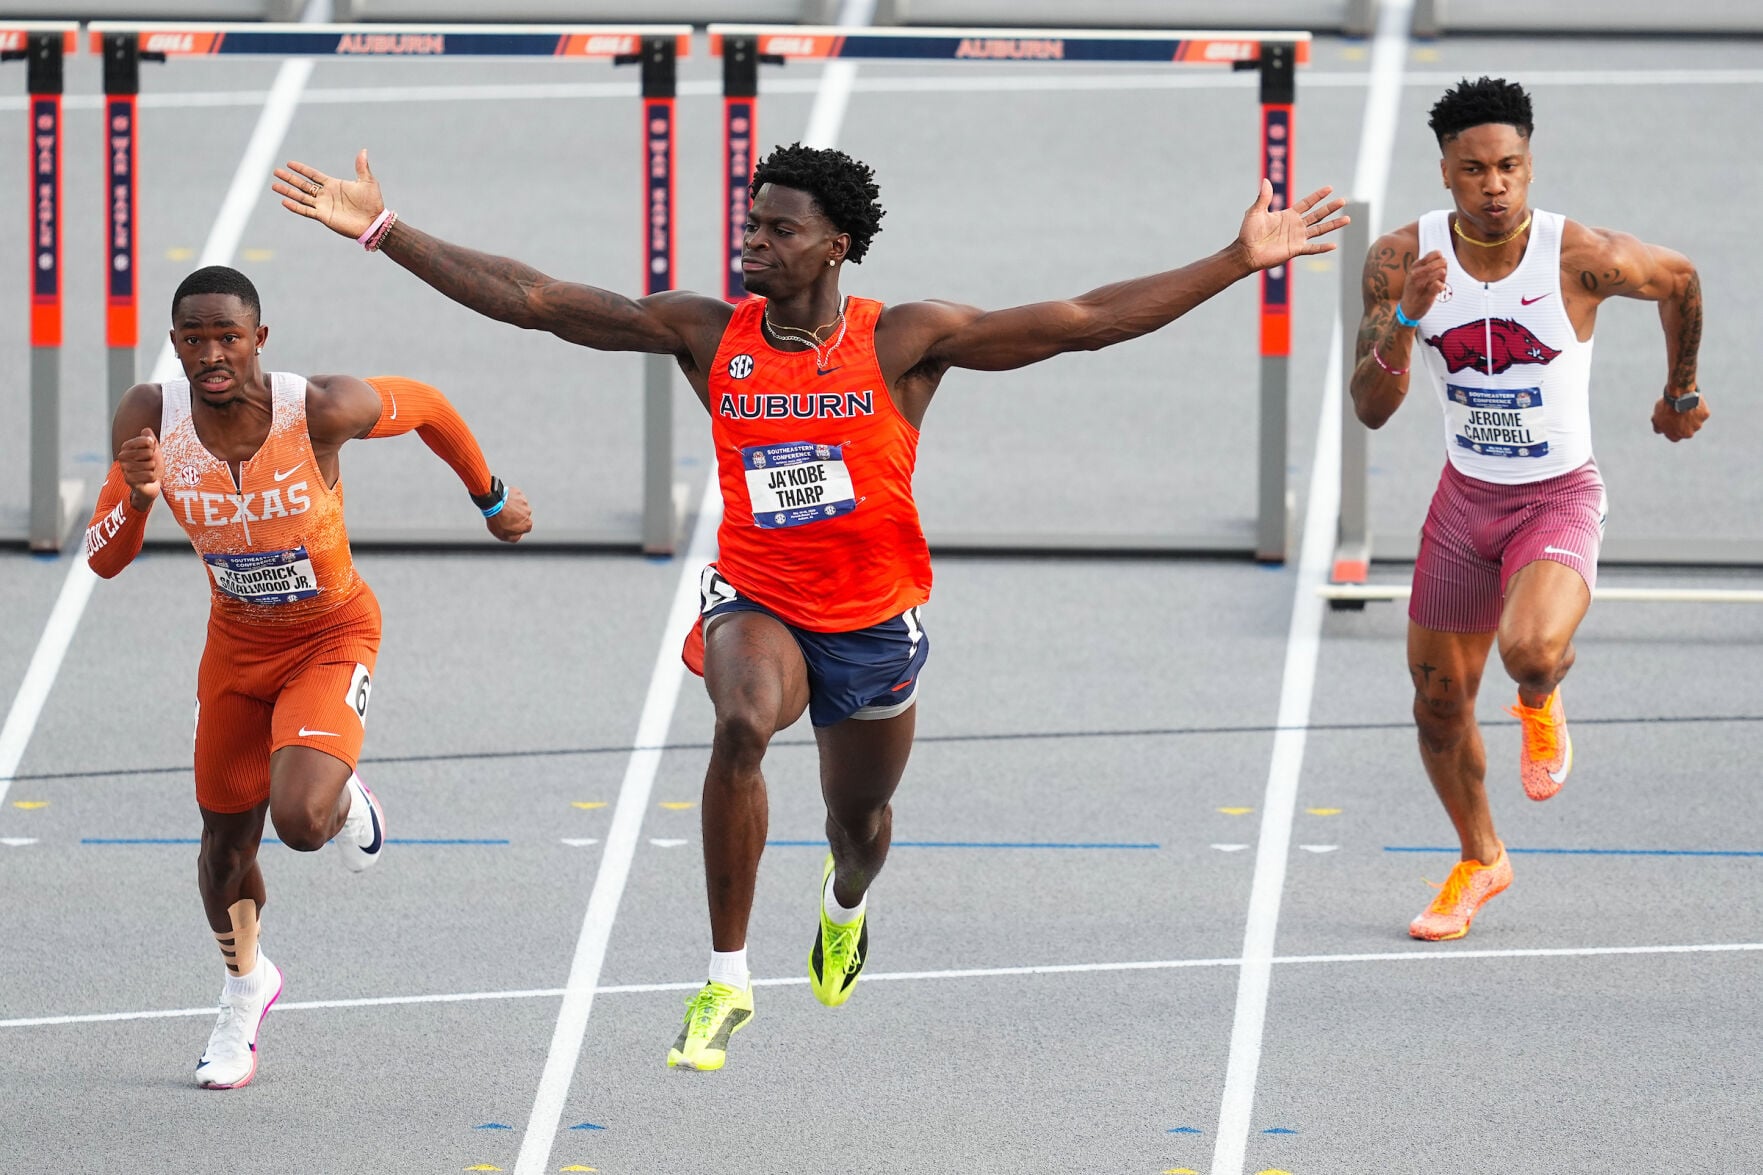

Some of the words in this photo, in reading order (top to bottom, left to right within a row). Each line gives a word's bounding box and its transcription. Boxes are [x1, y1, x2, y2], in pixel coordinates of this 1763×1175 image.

[336, 34, 444, 54] AUBURN
[955, 39, 1064, 59] AUBURN
[729, 354, 753, 379] SEC
[720, 390, 874, 419] AUBURN
[1468, 410, 1523, 427] JEROME
[1464, 425, 1535, 444] CAMPBELL
[767, 445, 814, 455] SOUTHEASTERN
[772, 451, 812, 461] CONFERENCE
[179, 465, 200, 485] SEC
[768, 464, 827, 489] JA'KOBE
[174, 481, 311, 526] TEXAS
[776, 485, 824, 508] THARP
[224, 565, 298, 584] KENDRICK
[219, 577, 291, 595] SMALLWOOD
[294, 575, 312, 590] JR.
[356, 675, 370, 716] 6
